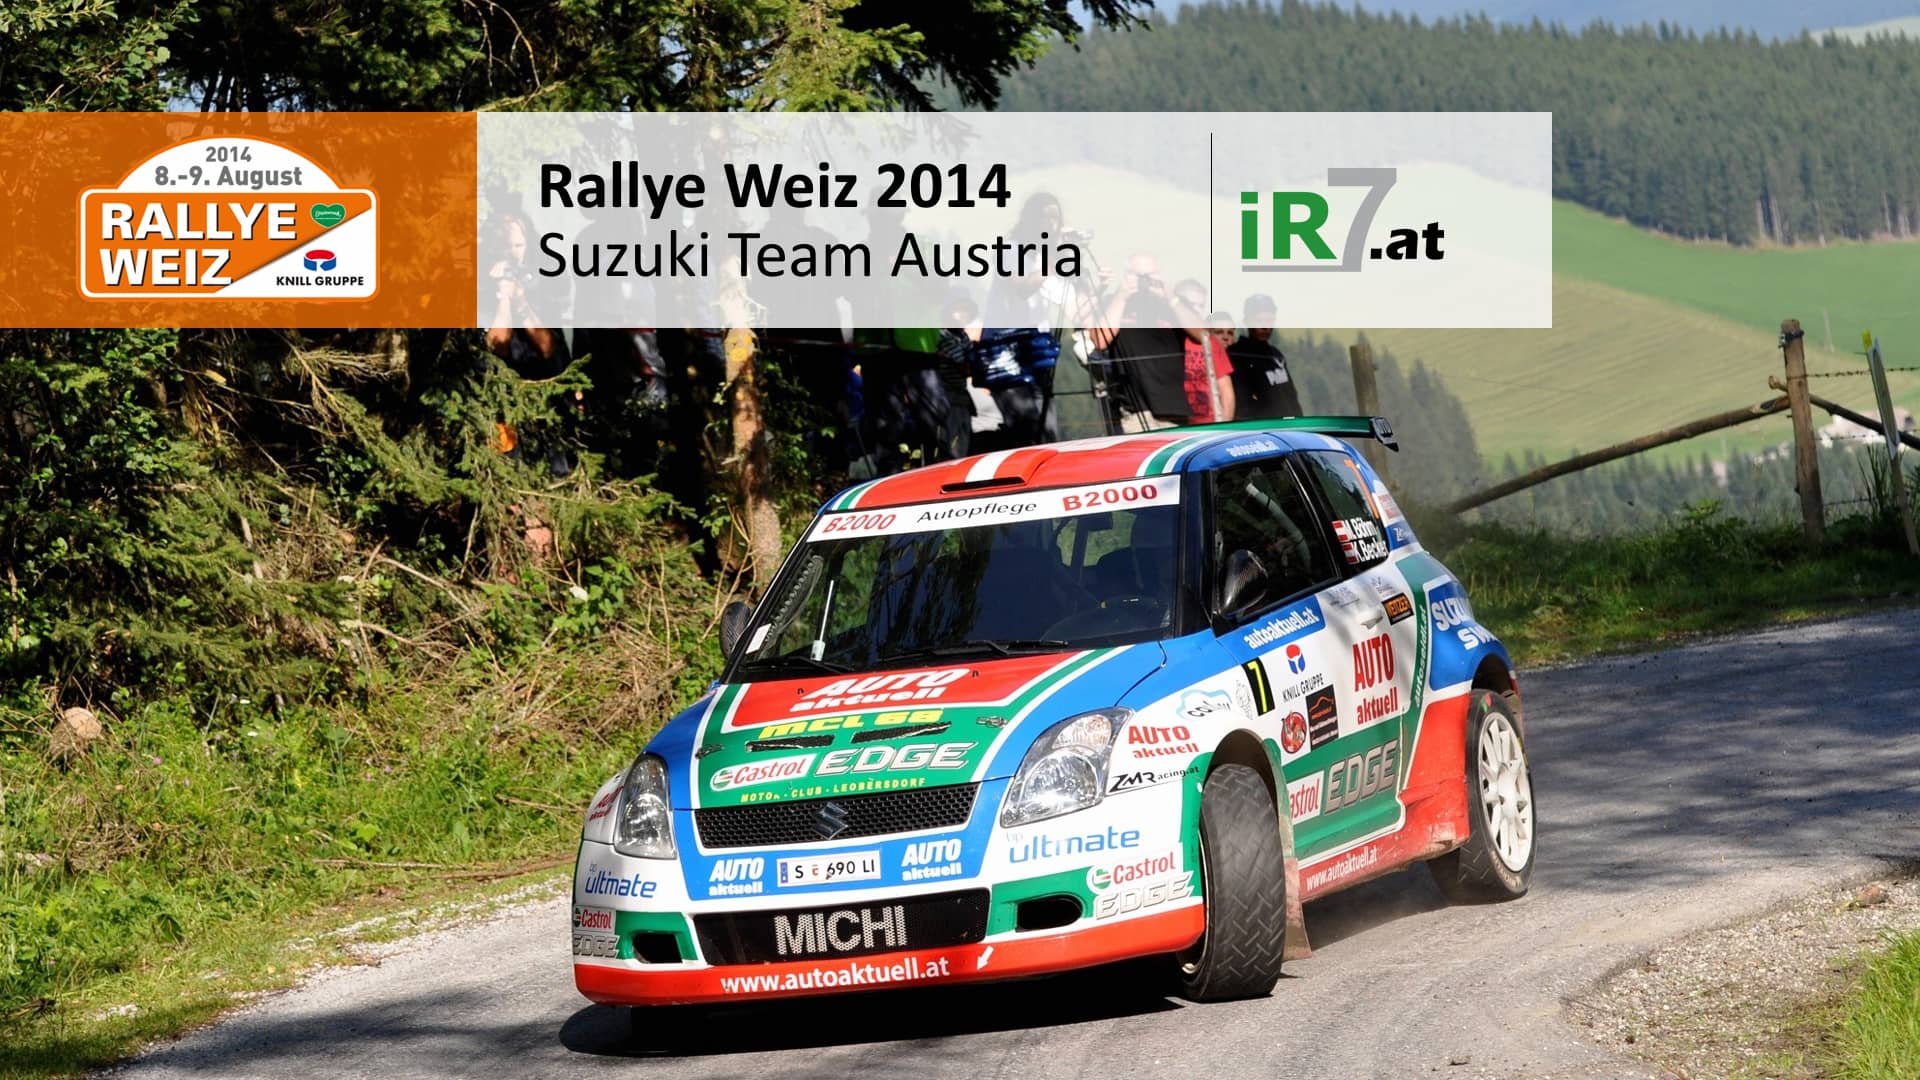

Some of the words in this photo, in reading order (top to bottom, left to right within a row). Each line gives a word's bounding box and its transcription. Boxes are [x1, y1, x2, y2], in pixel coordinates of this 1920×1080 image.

[822, 514, 896, 534] B2000
[917, 501, 1037, 524] Autopflege
[1063, 484, 1158, 511] B2000
[1244, 607, 1319, 649] autoaktuell.at
[1352, 633, 1394, 692] AUTO
[790, 687, 947, 712] aktuell
[802, 668, 970, 700] AUTO
[1282, 685, 1301, 702] KNILL
[1301, 673, 1324, 693] GRUPPE
[1357, 687, 1398, 725] aktuell
[1128, 725, 1191, 745] AUTO
[1133, 743, 1199, 759] aktuell
[733, 758, 806, 785] Castrol
[815, 741, 978, 776] EDGE
[1289, 778, 1320, 819] astrol
[1324, 738, 1399, 815] EDGE
[791, 786, 822, 798] CLUB
[833, 778, 926, 793] LEOBERSDORF
[902, 839, 962, 867] AUTO
[1009, 826, 1140, 864] ultimate
[585, 870, 657, 898] ultimate
[709, 857, 764, 882] AUTO
[795, 865, 804, 879] S
[827, 860, 855, 877] 690
[863, 859, 875, 873] LI
[902, 862, 962, 881] aktuell
[1113, 851, 1176, 885] Castrol
[1306, 846, 1377, 892] www.autoaktuell.at
[709, 881, 763, 896] aktuell
[1096, 872, 1194, 920] EDGE
[582, 909, 612, 928] Castrol
[774, 905, 908, 955] MICHI
[721, 956, 949, 994] www.autoaktuell.at
